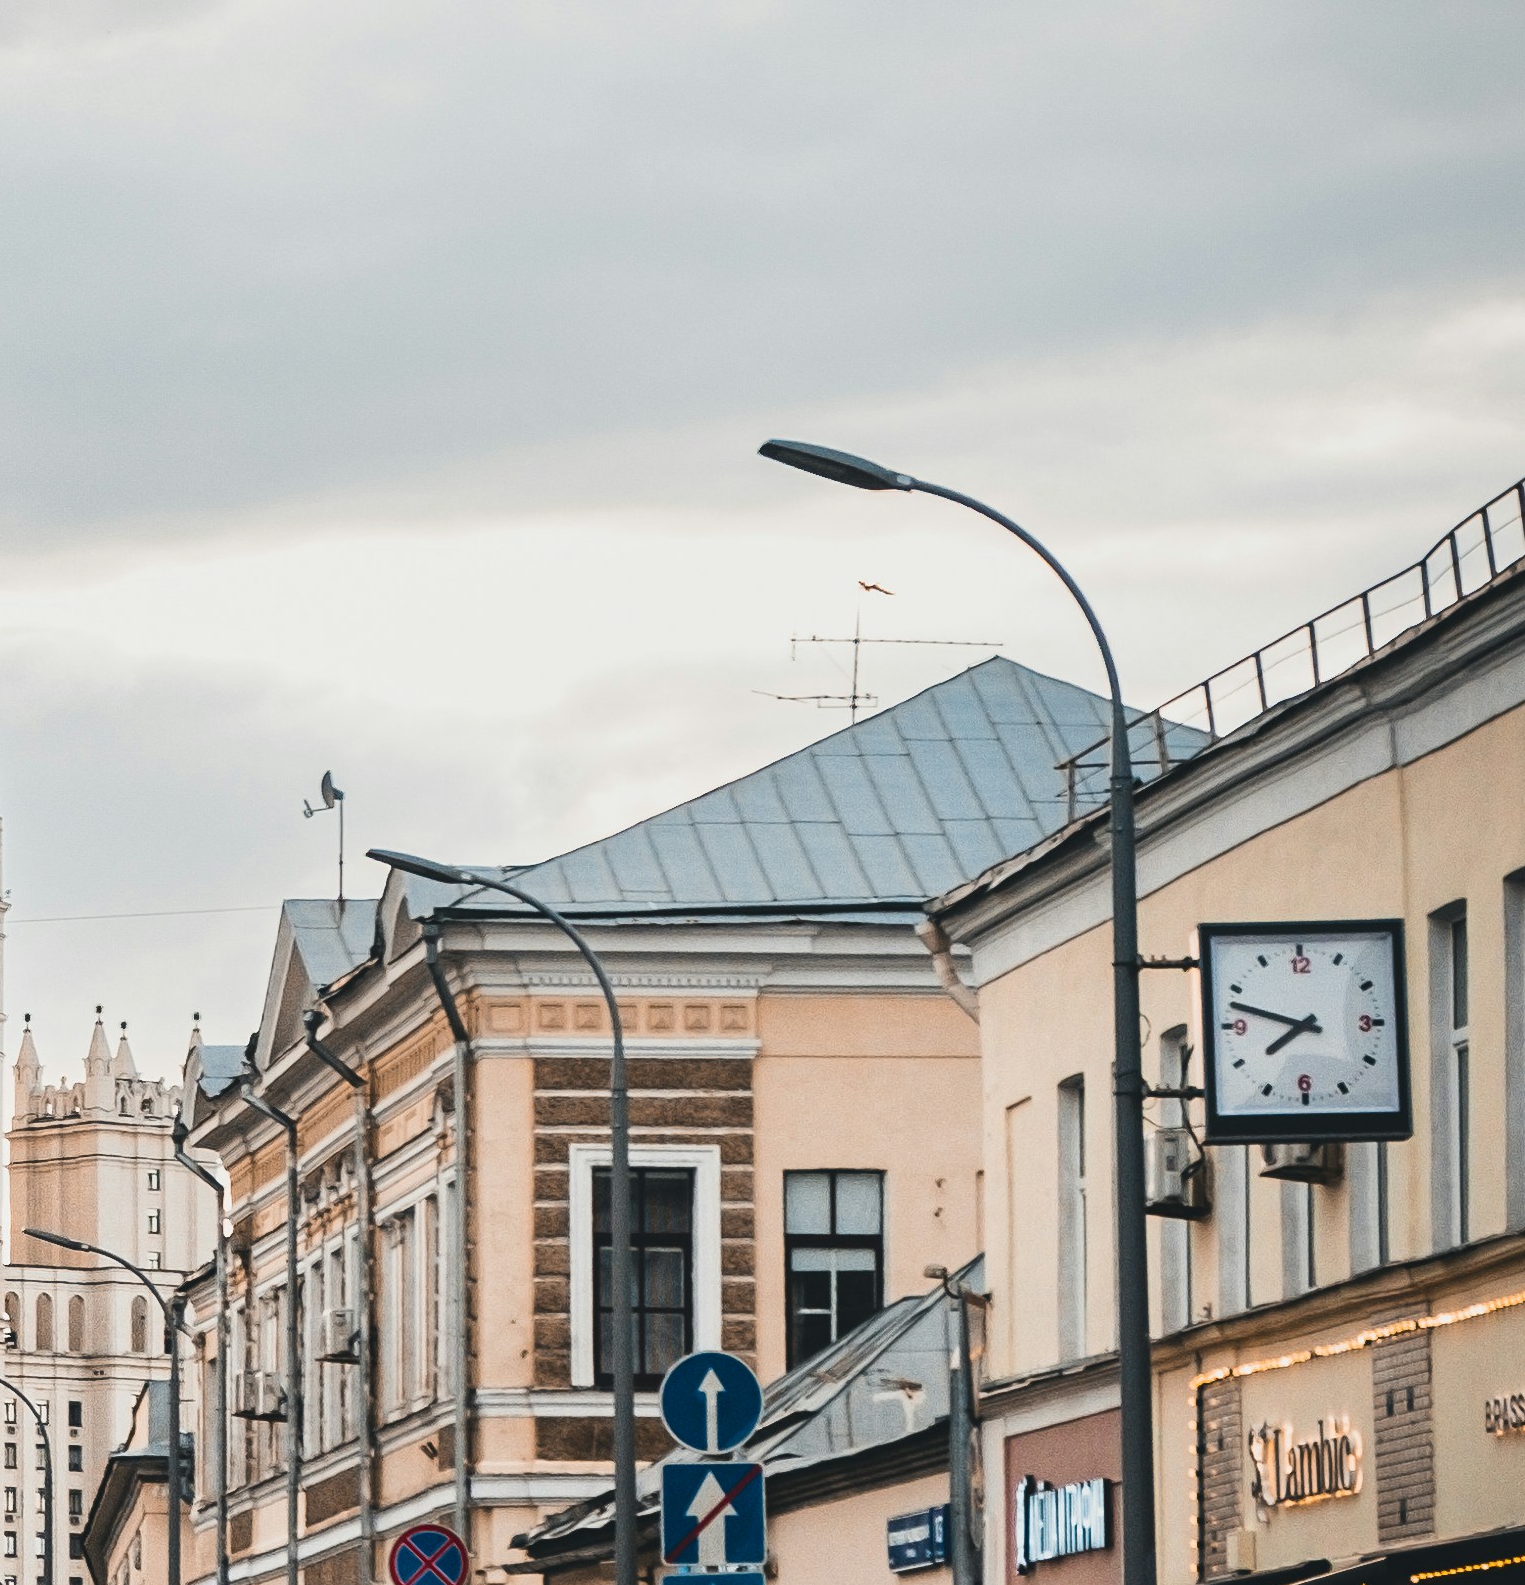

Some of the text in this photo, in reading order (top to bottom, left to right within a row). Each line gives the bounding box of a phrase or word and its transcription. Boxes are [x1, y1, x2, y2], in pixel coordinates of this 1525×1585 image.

[1290, 956, 1312, 974] 12
[1232, 1018, 1248, 1036] 9
[1358, 1014, 1373, 1033] 3
[1297, 1073, 1312, 1093] 6
